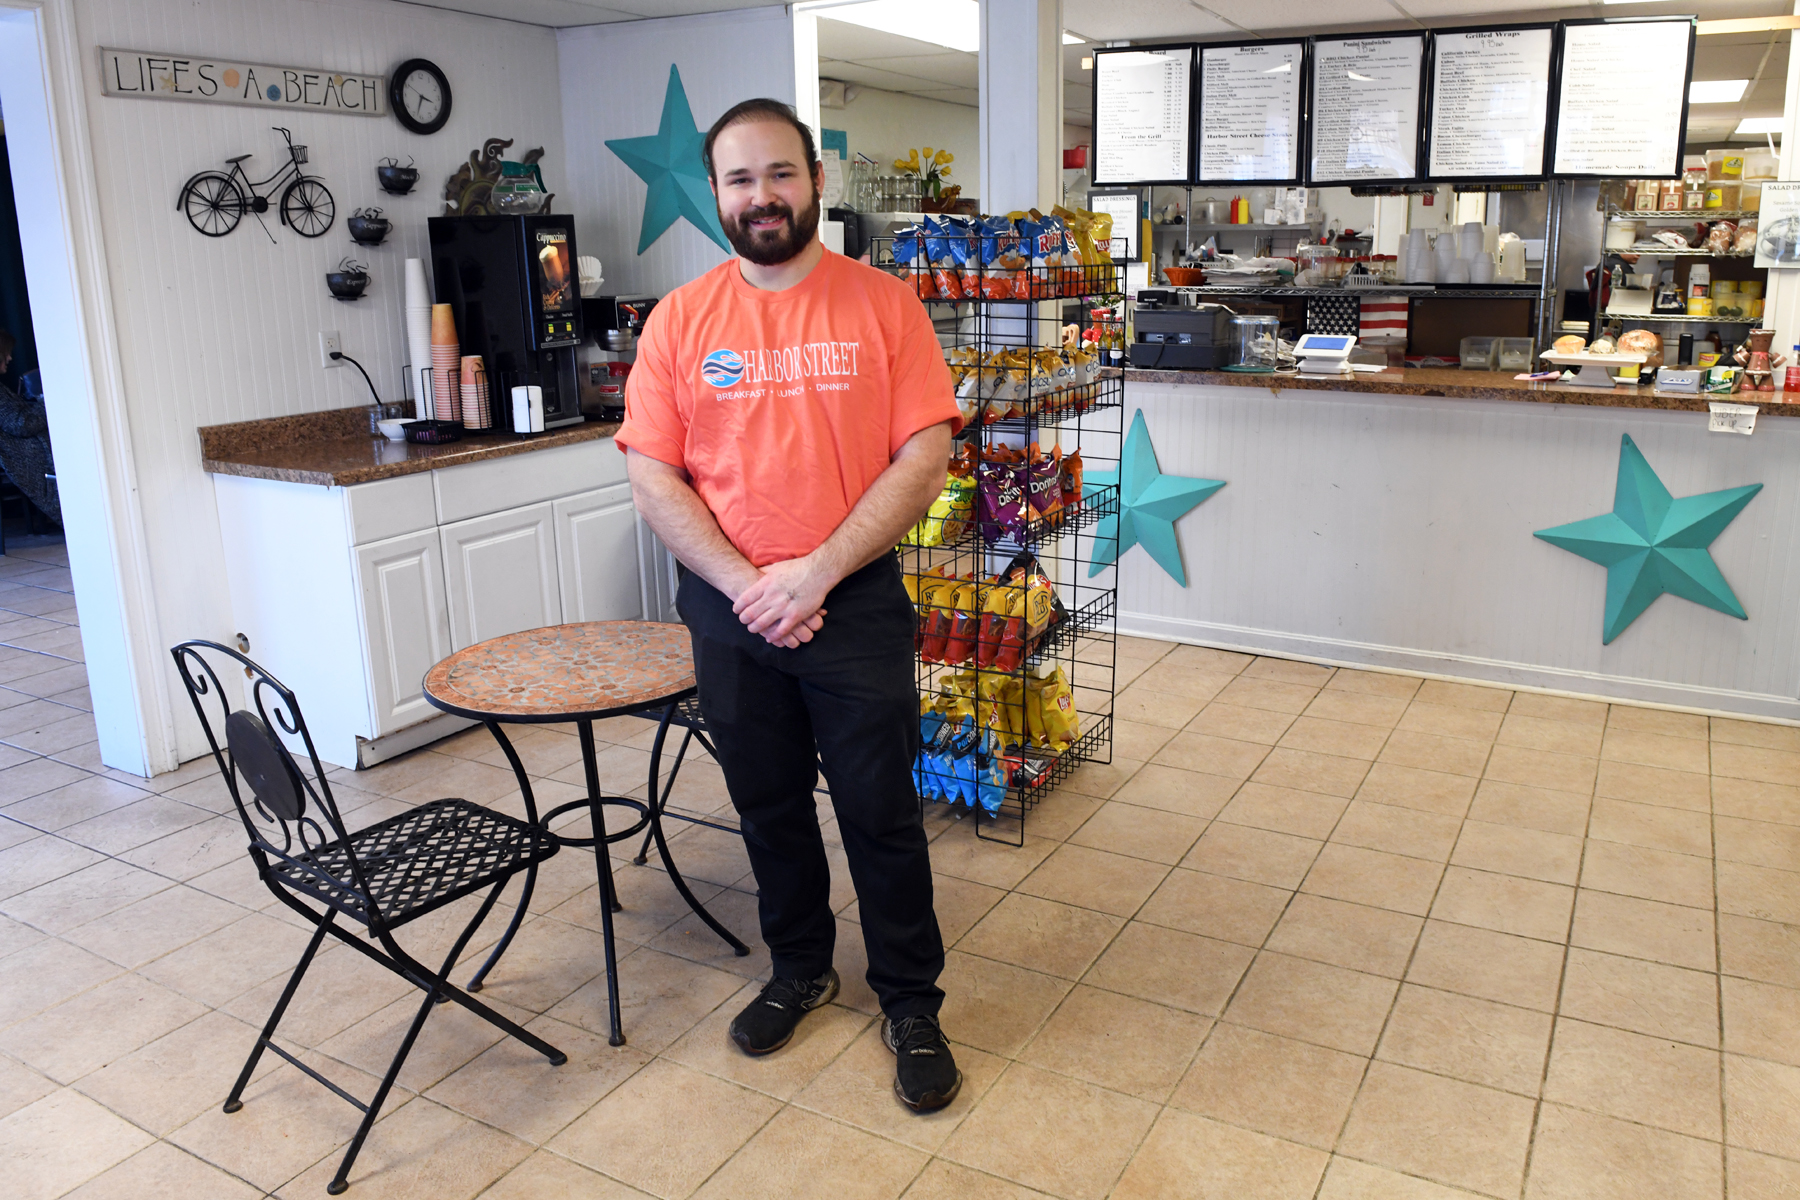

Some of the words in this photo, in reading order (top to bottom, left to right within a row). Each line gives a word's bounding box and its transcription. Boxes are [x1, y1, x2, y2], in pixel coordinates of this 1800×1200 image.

[244, 68, 263, 100] A
[284, 71, 379, 111] BEACH
[536, 232, 566, 244] Cappuccino
[743, 346, 802, 384] HARBOR
[803, 342, 860, 378] STREET
[716, 388, 766, 402] BREAKFAST
[816, 383, 850, 392] DINNER
[1714, 408, 1742, 419] UBER
